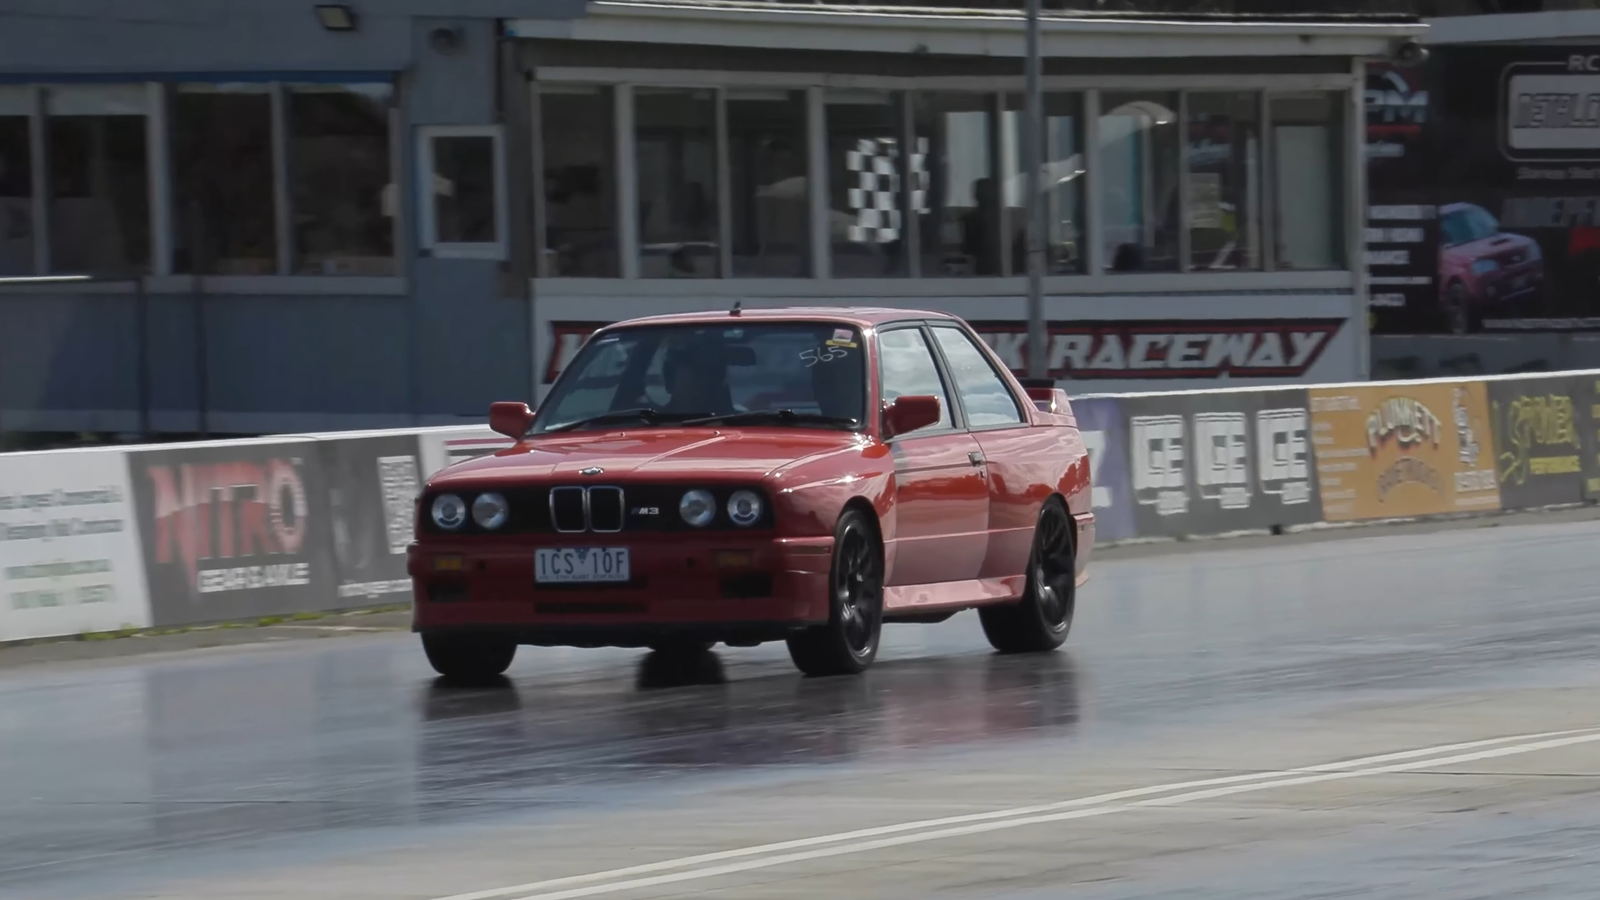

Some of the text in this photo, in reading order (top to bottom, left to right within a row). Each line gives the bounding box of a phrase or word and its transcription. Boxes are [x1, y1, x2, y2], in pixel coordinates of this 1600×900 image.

[799, 345, 848, 367] 565
[1052, 331, 1329, 370] RACEWAY
[639, 507, 659, 515] M3
[147, 458, 308, 602] NITRO
